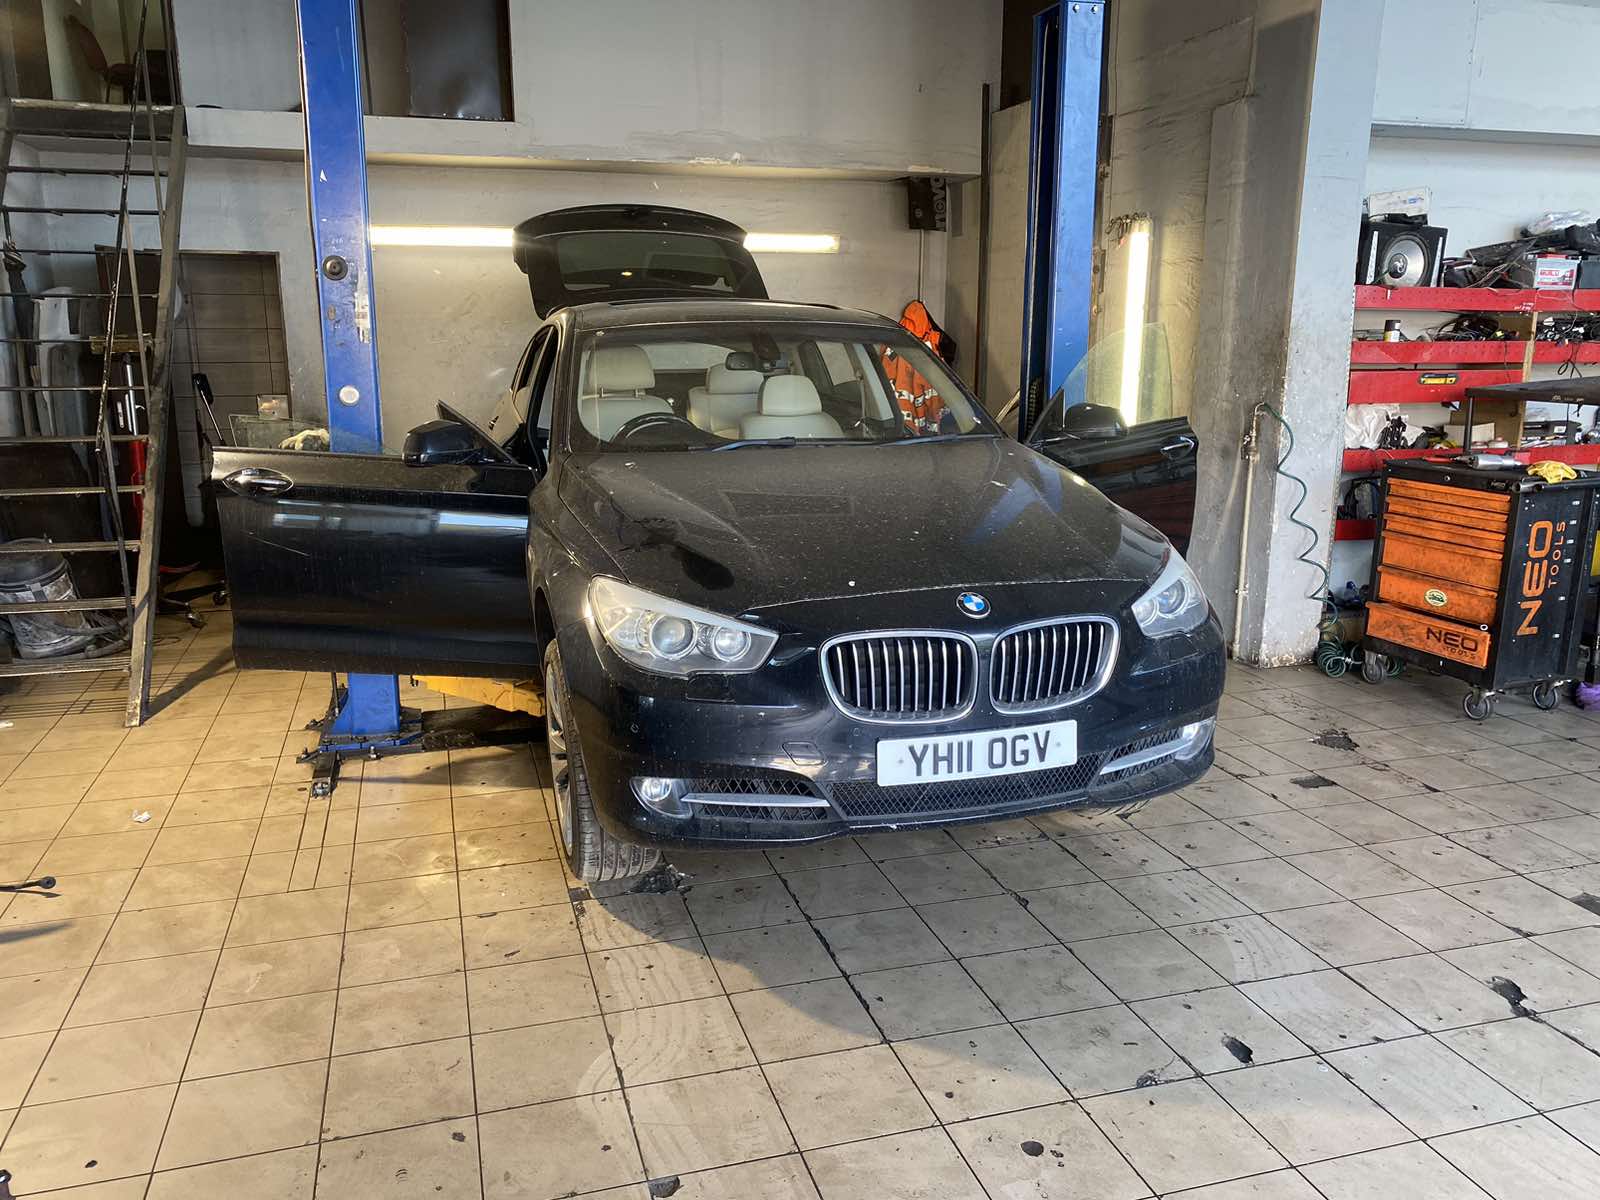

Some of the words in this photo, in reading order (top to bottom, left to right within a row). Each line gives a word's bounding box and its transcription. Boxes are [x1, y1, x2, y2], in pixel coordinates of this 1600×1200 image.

[1517, 520, 1553, 635] NEO
[1547, 521, 1566, 588] TOOLS
[1426, 626, 1478, 652] NEO
[908, 739, 973, 777] YH11
[988, 730, 1051, 769] OGV
